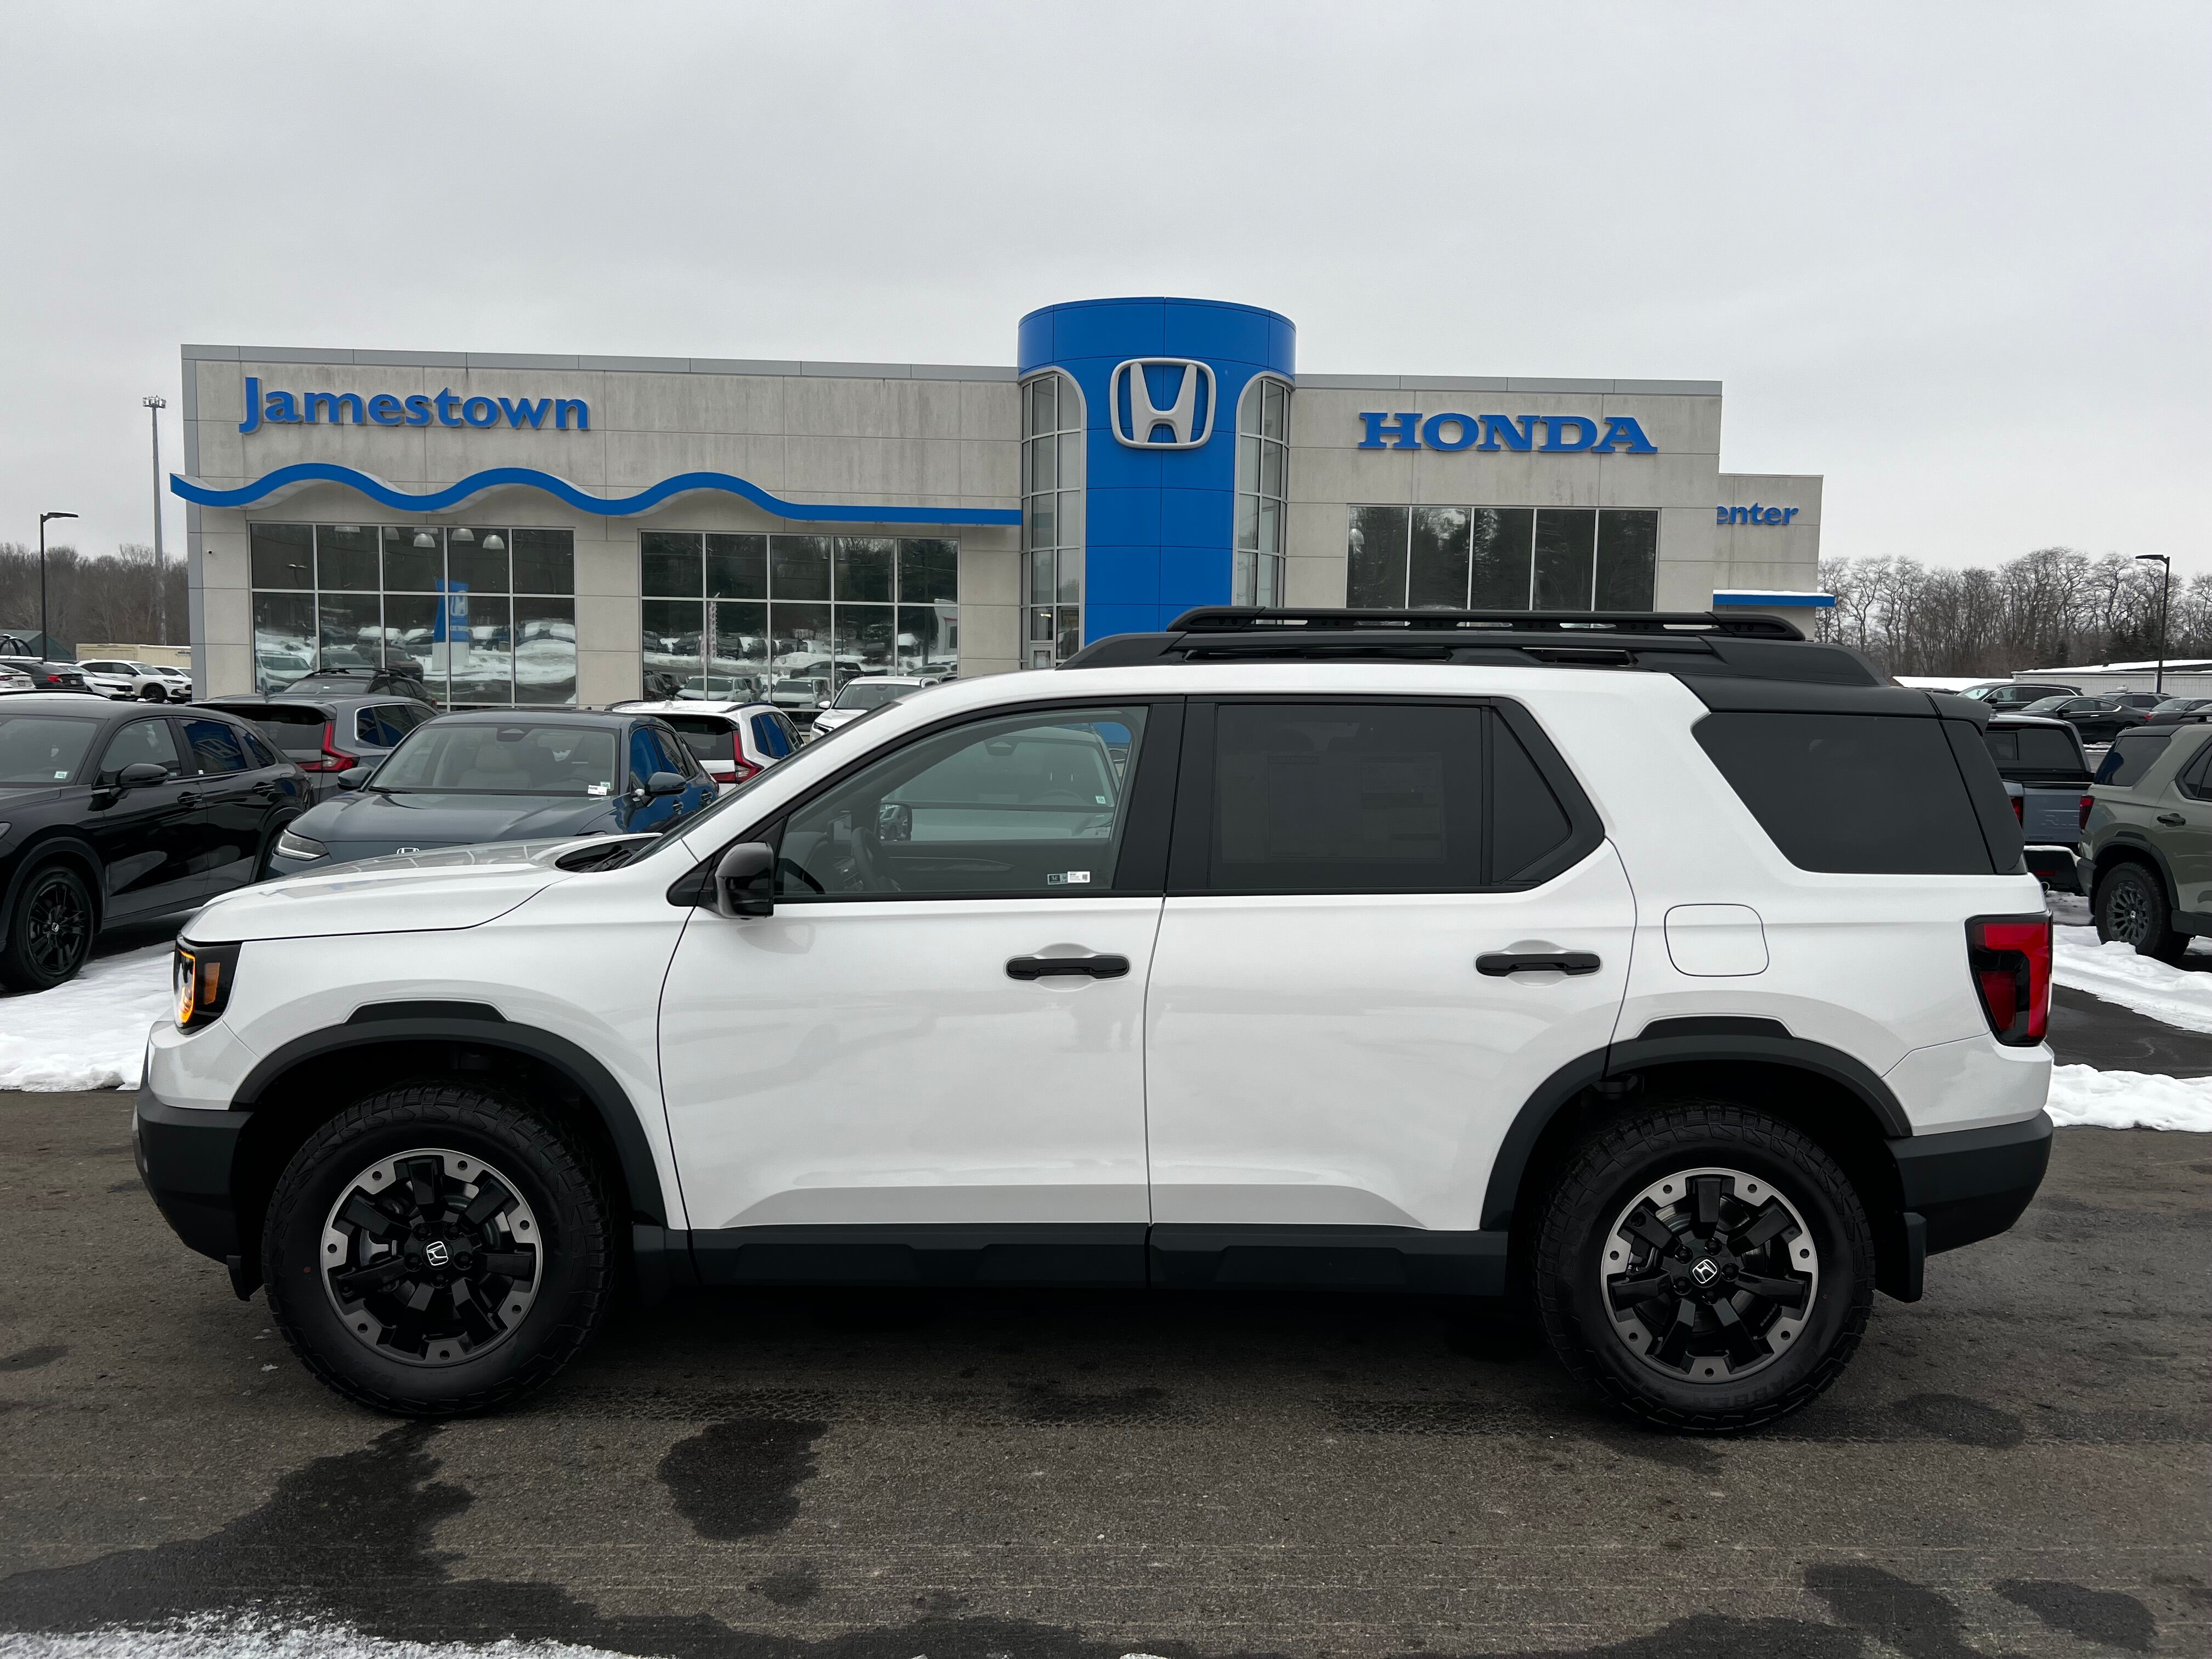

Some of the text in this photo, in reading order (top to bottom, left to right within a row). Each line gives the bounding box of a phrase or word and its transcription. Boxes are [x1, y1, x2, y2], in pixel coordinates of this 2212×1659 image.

[239, 377, 590, 434] Jamestown
[1357, 412, 1658, 453] HONDA
[1717, 503, 1799, 525] enter
